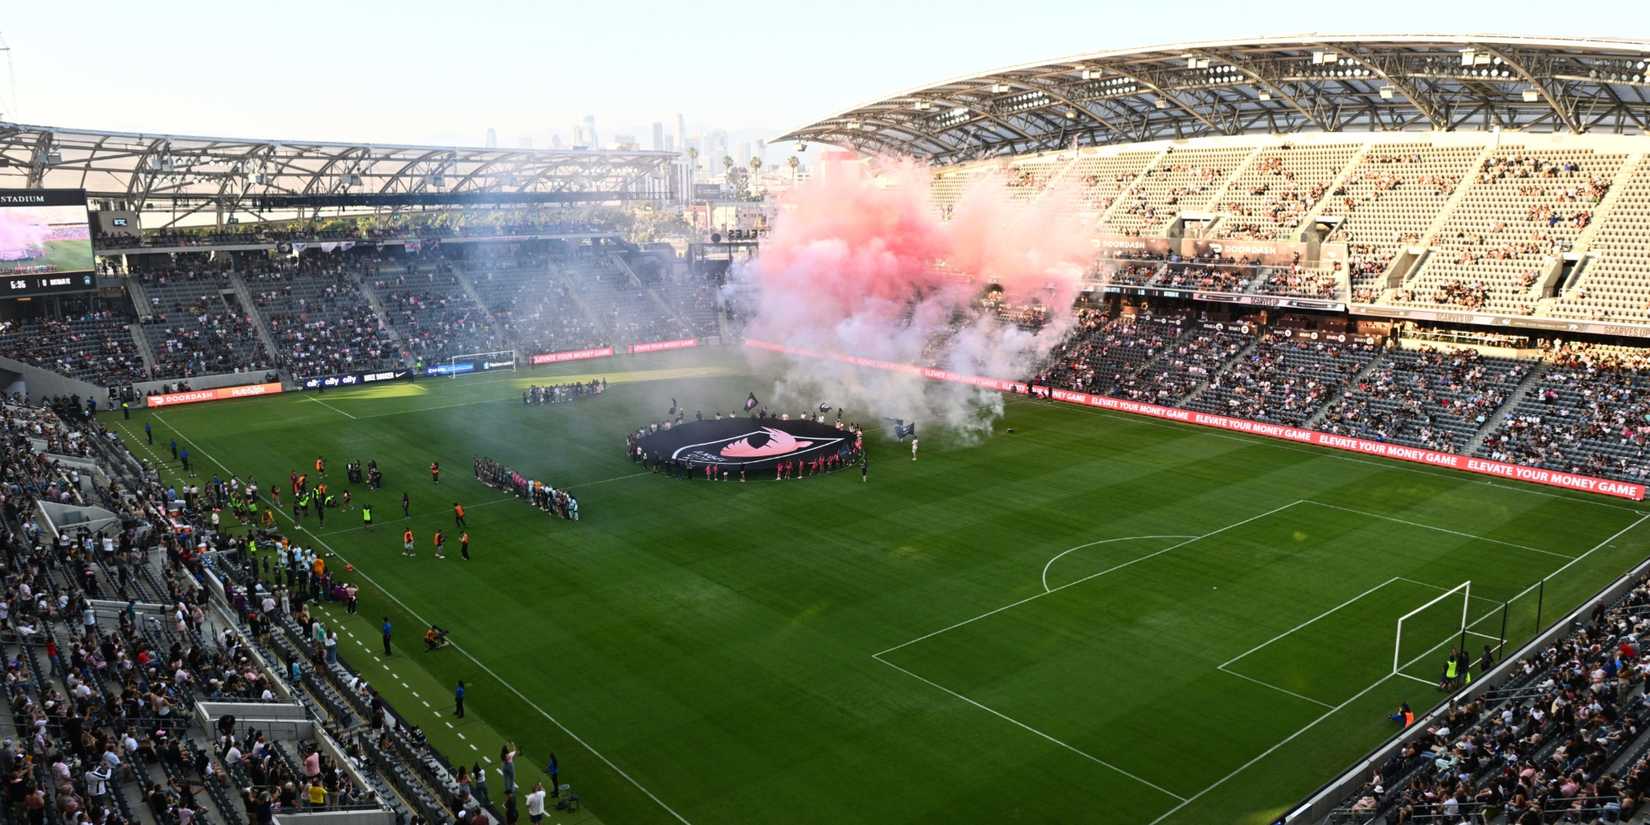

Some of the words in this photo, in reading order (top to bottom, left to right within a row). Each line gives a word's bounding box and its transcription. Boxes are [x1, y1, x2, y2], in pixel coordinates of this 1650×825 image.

[0, 195, 44, 203] STADIUM
[1226, 246, 1276, 255] DOORDASH
[325, 377, 339, 386] ally
[342, 375, 356, 384] ally
[166, 391, 213, 401] DOORDASH
[1067, 392, 1086, 402] GAME
[1092, 397, 1118, 409] ELEVATE
[1119, 401, 1139, 412] YOUR
[1140, 404, 1166, 416] MONEY
[1166, 409, 1188, 420] GAME
[1195, 414, 1227, 426] ELEVATE
[1229, 419, 1251, 431] YOUR
[1252, 423, 1284, 436] MONEY
[1284, 429, 1311, 441] GAME
[1319, 434, 1356, 449] ELEVATE
[1359, 440, 1386, 454] YOUR
[1387, 445, 1425, 461] MONEY
[1426, 452, 1457, 466] GAME
[1467, 459, 1513, 476] ELEVATE
[1516, 467, 1549, 482] YOUR
[1550, 473, 1596, 490] MONEY
[1598, 482, 1637, 497] GAME
